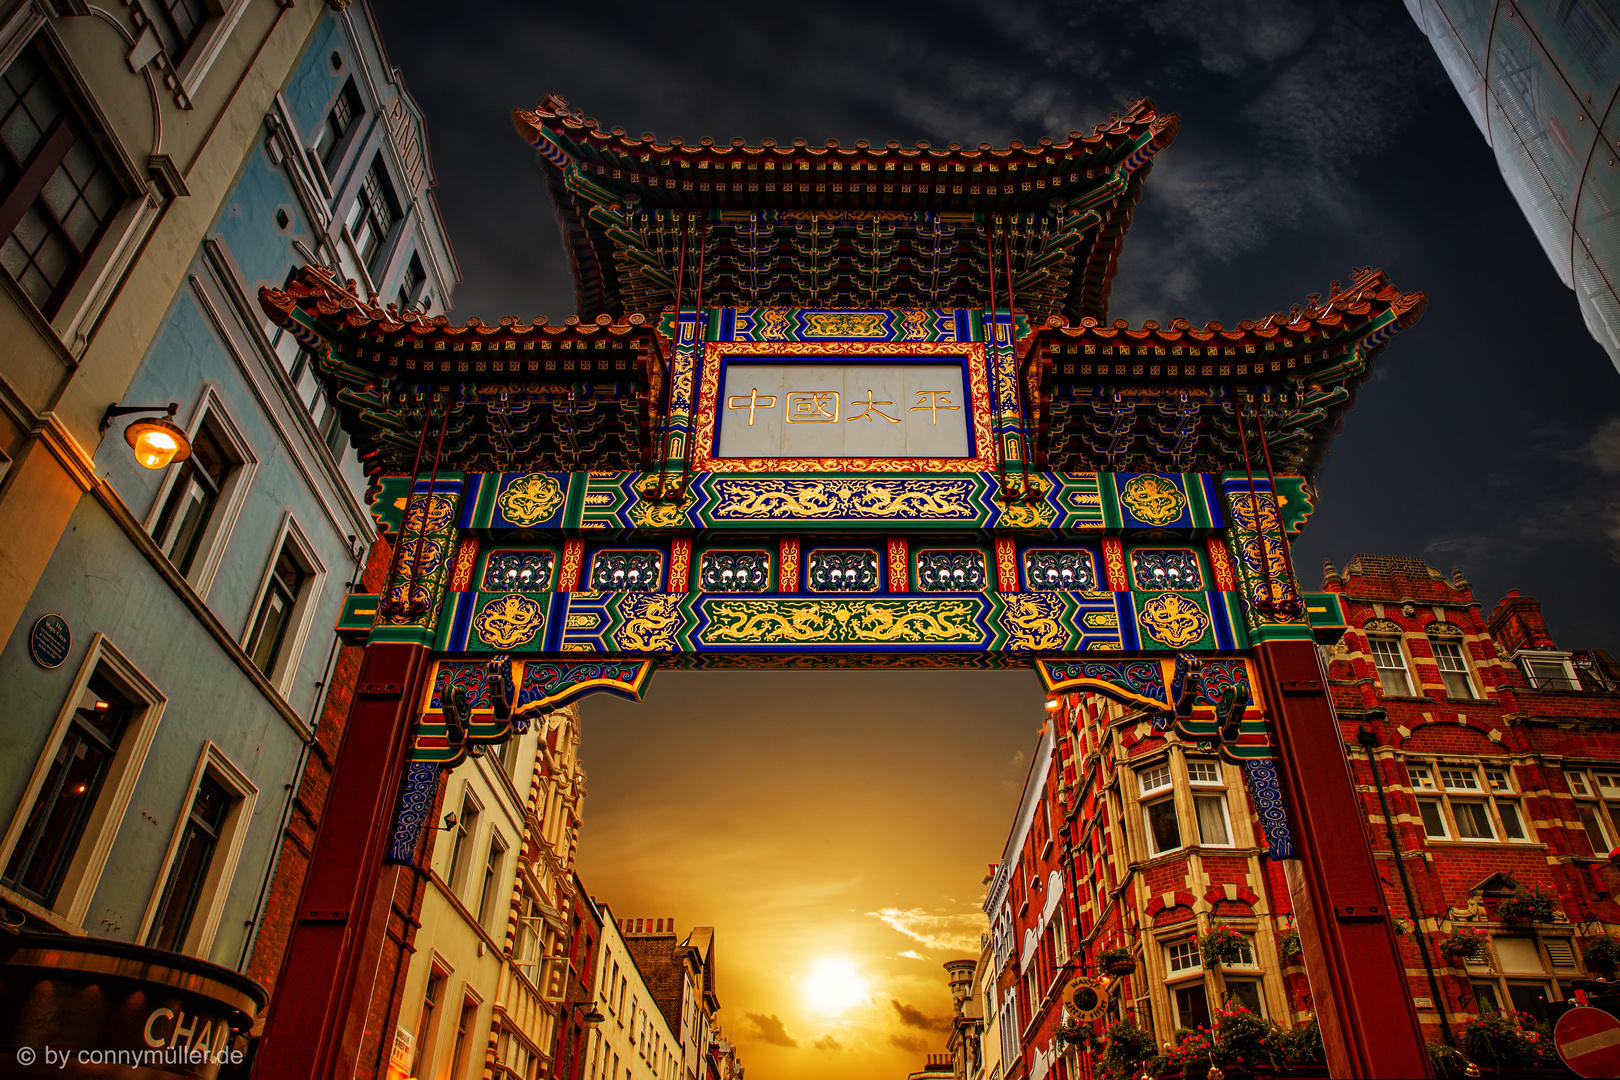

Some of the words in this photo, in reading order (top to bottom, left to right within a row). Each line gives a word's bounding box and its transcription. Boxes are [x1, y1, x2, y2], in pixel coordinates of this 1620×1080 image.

[389, 98, 425, 194] PINOLI
[727, 388, 961, 427] 中國太平
